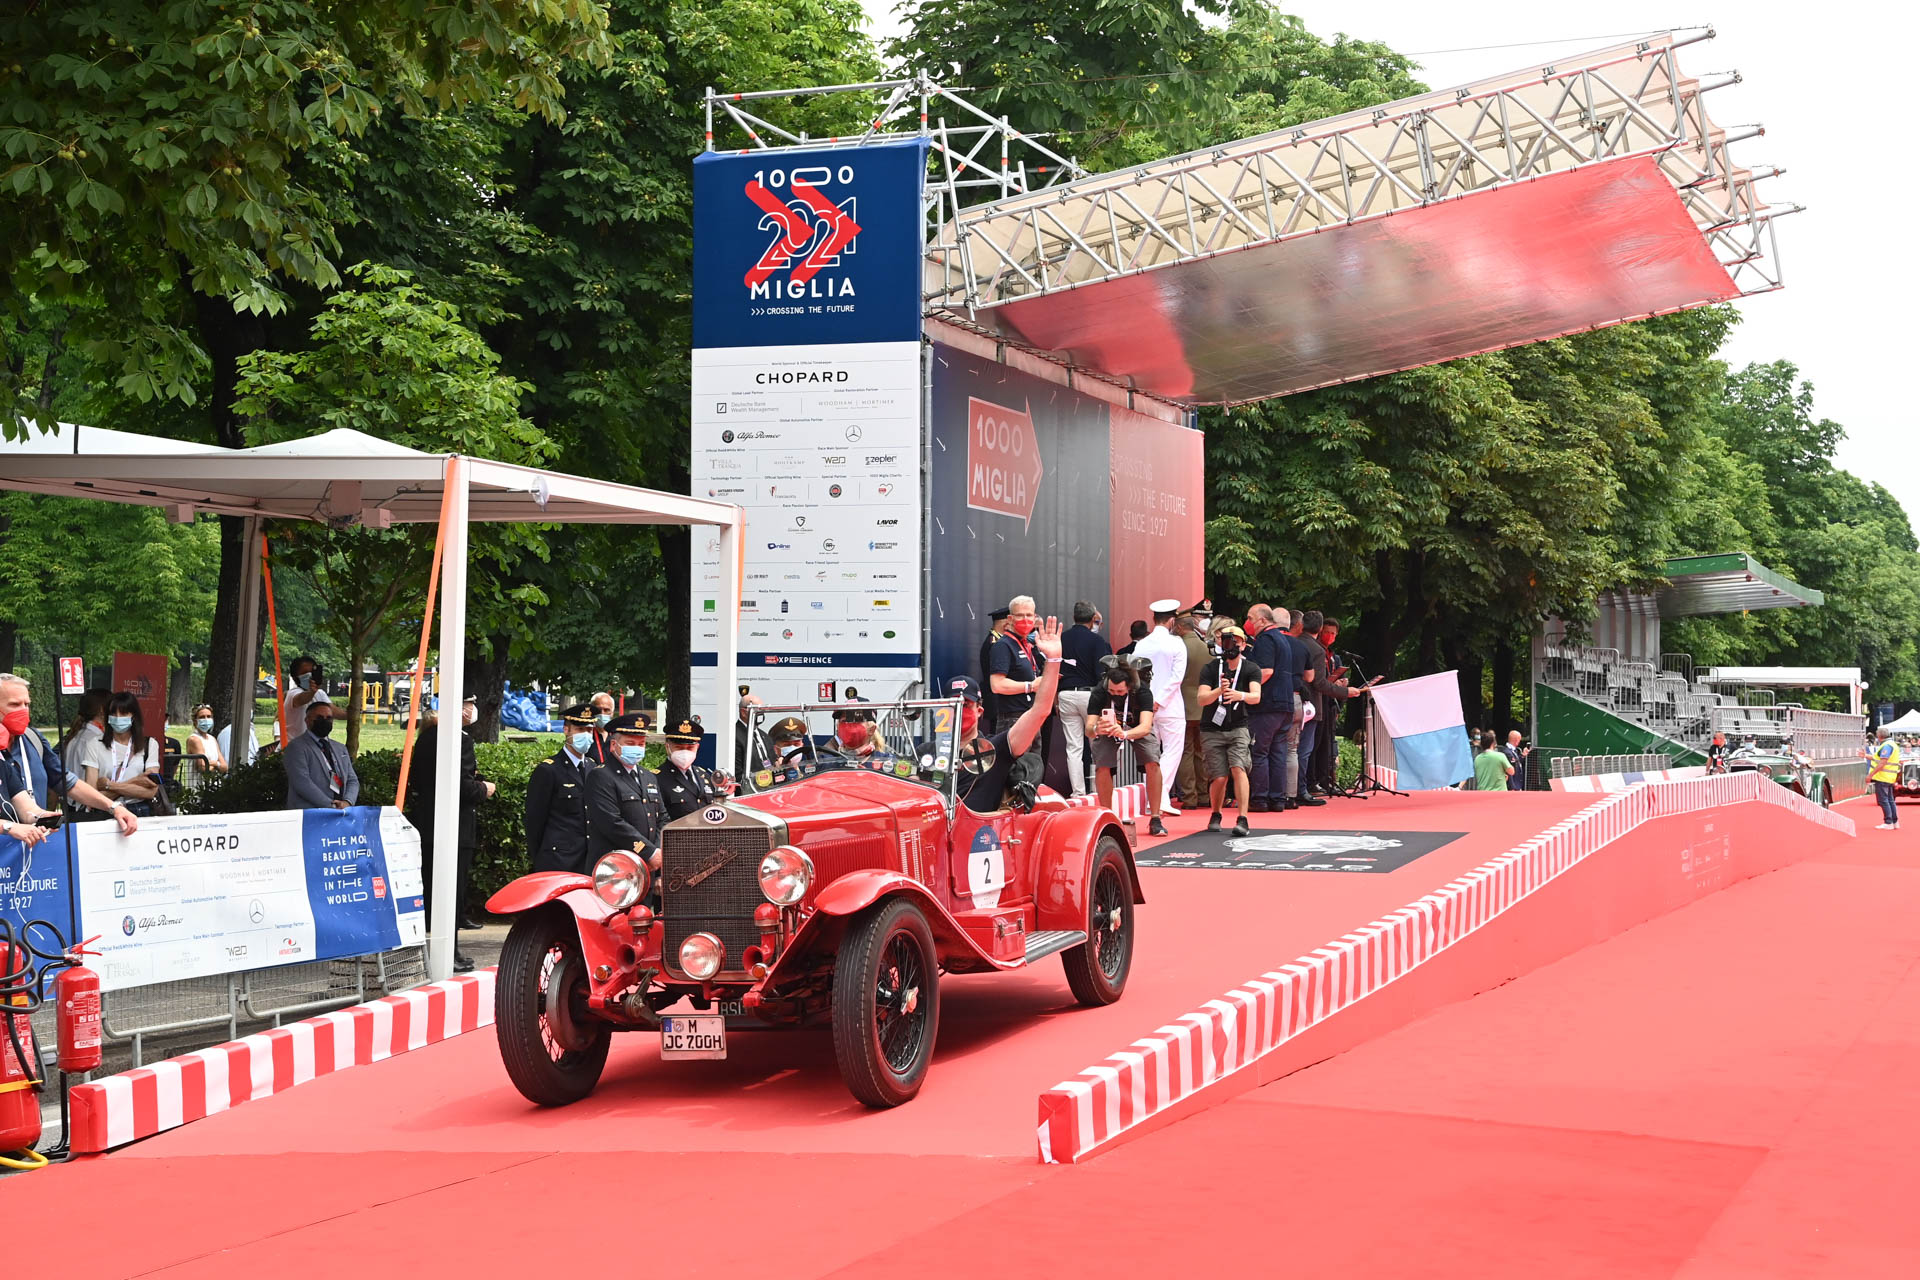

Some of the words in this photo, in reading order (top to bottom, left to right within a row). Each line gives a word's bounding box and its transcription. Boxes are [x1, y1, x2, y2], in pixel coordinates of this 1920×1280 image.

[754, 165, 854, 189] 1000
[757, 197, 857, 270] 2021
[750, 277, 856, 300] MIGLIA
[766, 306, 804, 315] CROSSING
[808, 305, 822, 314] THE
[826, 304, 855, 313] FUTURE
[756, 371, 849, 385] CHOPARD
[736, 431, 754, 442] Alfa
[976, 413, 1024, 457] 1000
[972, 463, 1026, 507] MIGLIA
[1142, 487, 1156, 509] THE
[1160, 492, 1187, 516] FUTURE
[1122, 509, 1146, 533] SINCE
[1150, 516, 1168, 537] 1927
[778, 656, 832, 664] XPERIENCE
[934, 708, 951, 733] 2
[1905, 764, 1917, 780] 4
[707, 809, 723, 820] OM
[156, 834, 240, 855] CHOPARD
[321, 837, 347, 847] THE
[323, 864, 357, 877] RACE
[983, 857, 991, 884] 2
[23, 878, 58, 892] FUTURE
[324, 881, 334, 891] IN
[337, 878, 363, 889] THE
[9, 896, 32, 910] 1927
[327, 891, 368, 905] WORLD
[138, 917, 156, 932] Alfa
[157, 914, 184, 926] Romeo
[688, 1019, 697, 1033] M
[665, 1035, 683, 1049] JC
[686, 1035, 722, 1049] 700H
